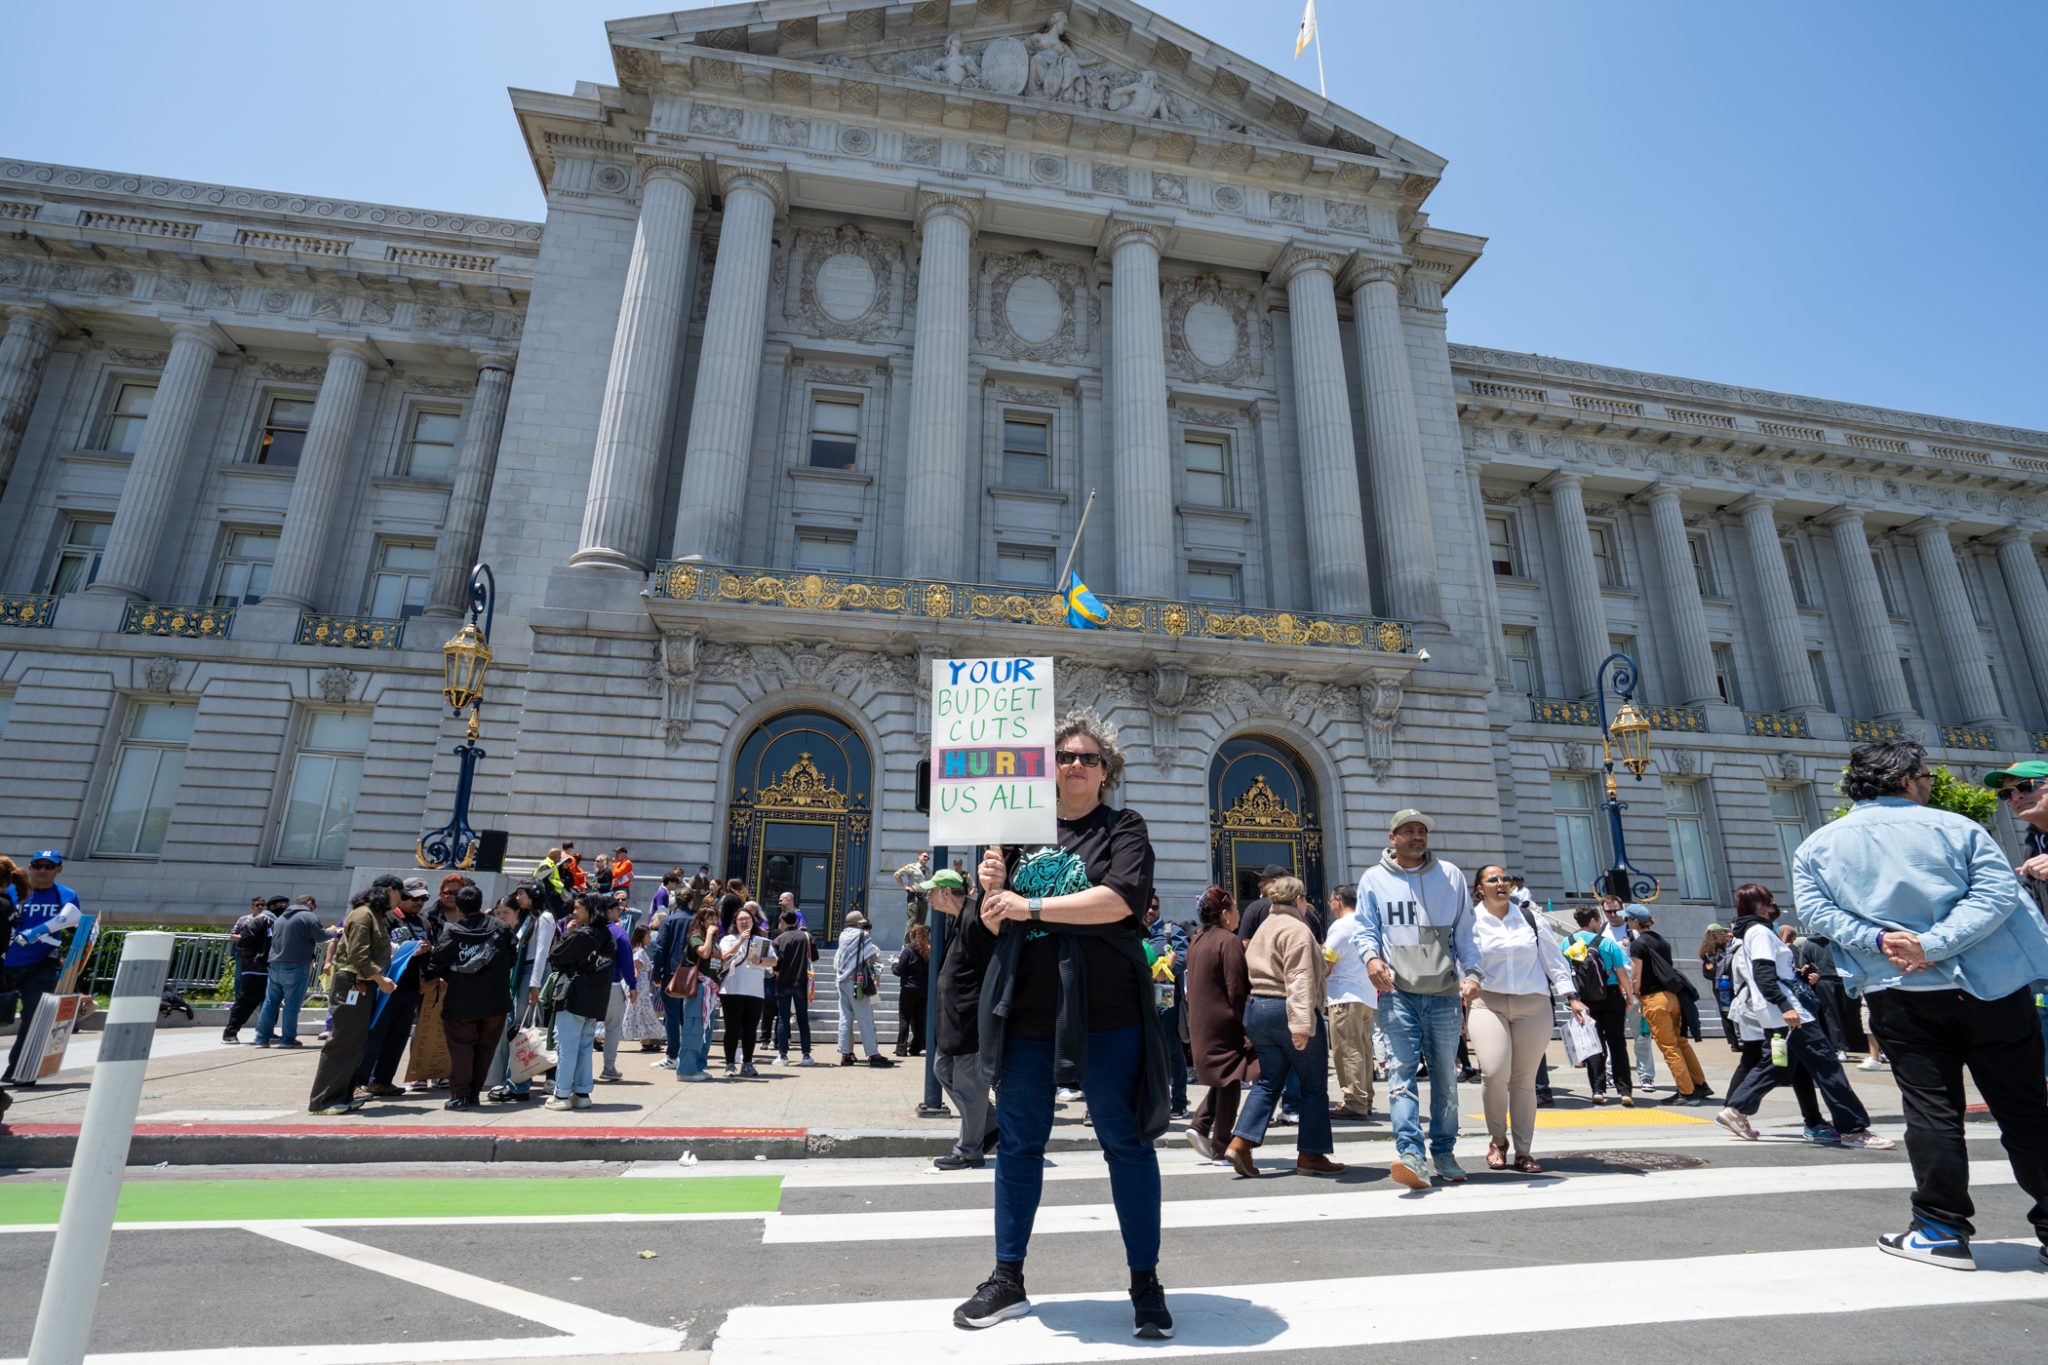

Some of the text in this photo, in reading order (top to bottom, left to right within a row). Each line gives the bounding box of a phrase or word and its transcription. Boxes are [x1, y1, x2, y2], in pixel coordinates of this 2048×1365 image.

[949, 659, 1036, 685] YOUR
[938, 687, 1042, 717] BUDGET
[949, 716, 1028, 742] CUTS
[945, 751, 1040, 777] HURT
[941, 784, 1045, 814] US ALL
